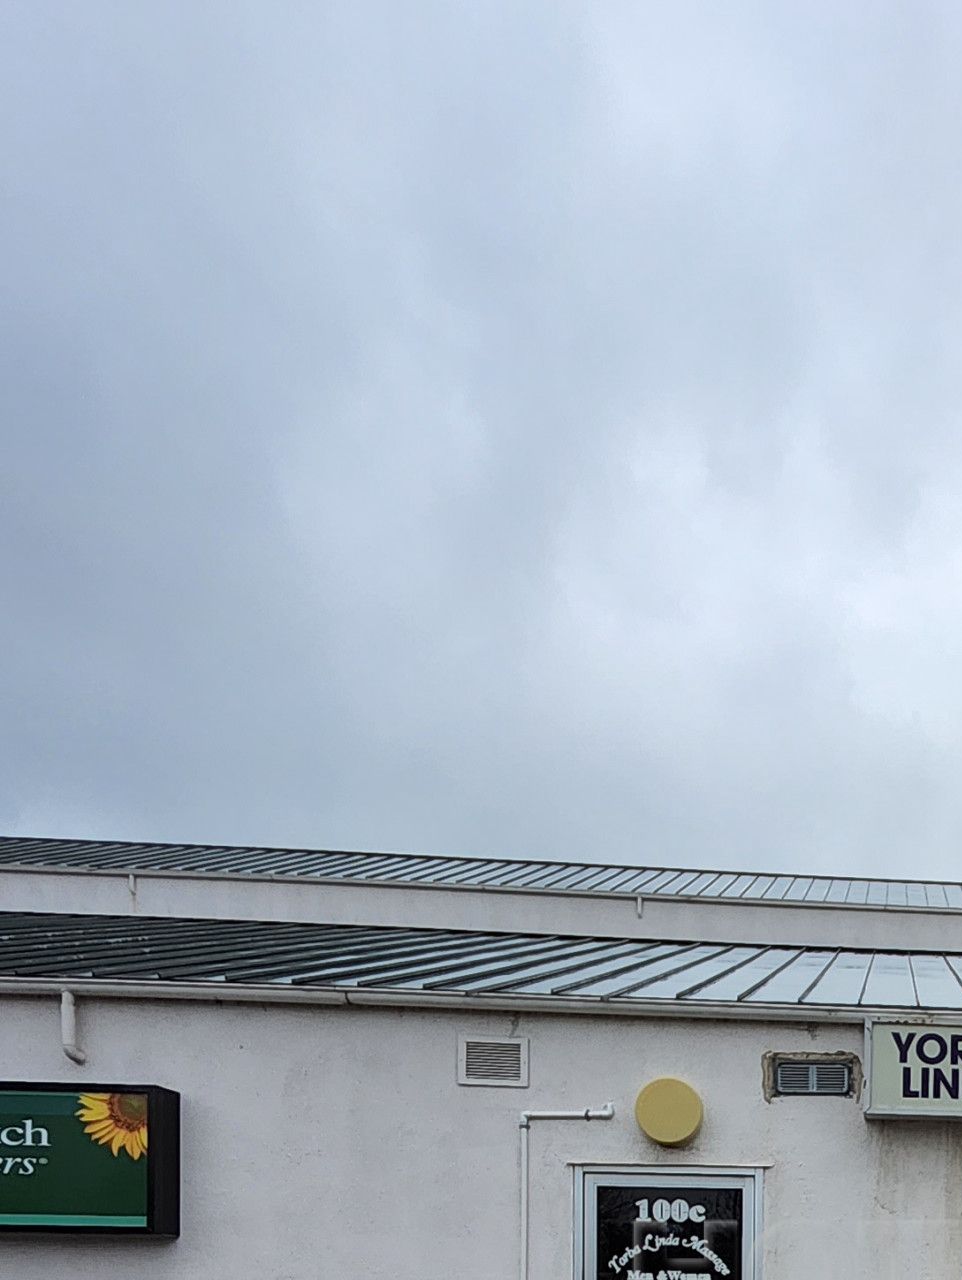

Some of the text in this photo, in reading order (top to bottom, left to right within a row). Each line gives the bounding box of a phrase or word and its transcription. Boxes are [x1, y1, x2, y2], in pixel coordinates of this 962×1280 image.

[0, 1119, 52, 1147] ch
[634, 1198, 707, 1223] 100c
[643, 1233, 680, 1252] Linda
[681, 1235, 731, 1276] Massage
[626, 1270, 654, 1280] Men
